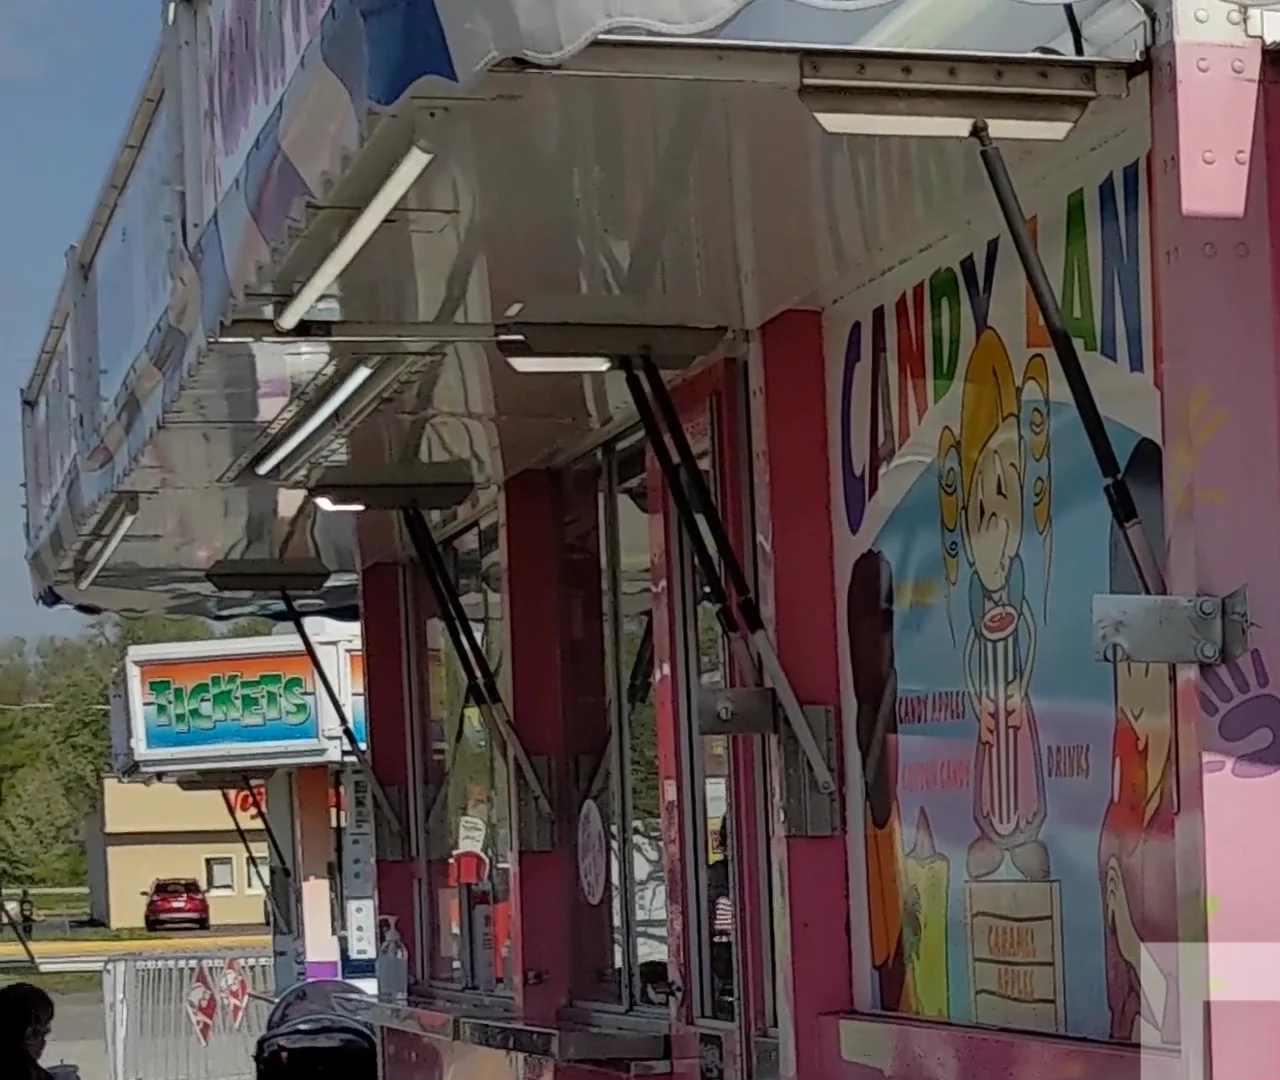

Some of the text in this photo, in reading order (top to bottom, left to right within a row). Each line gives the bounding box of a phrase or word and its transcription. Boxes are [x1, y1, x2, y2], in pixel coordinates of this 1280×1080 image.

[841, 149, 1161, 536] CANDY LAN
[148, 672, 311, 734] TICKETS
[898, 690, 967, 725] CANDY APPLES
[1046, 743, 1091, 780] DRINKS
